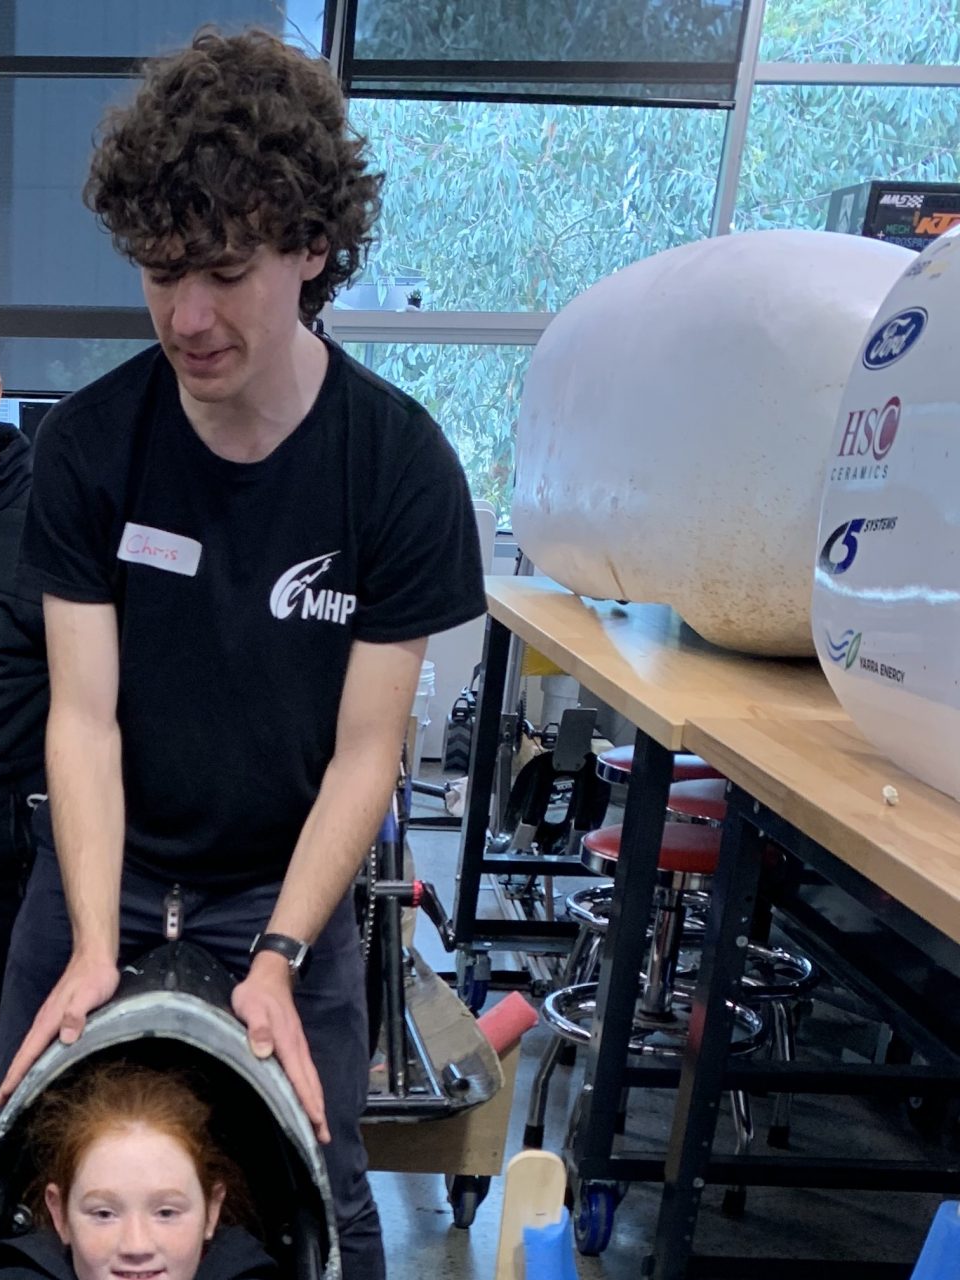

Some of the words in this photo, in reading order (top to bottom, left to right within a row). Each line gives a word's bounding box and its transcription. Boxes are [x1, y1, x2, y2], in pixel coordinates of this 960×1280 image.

[915, 213, 960, 234] KT
[885, 236, 937, 249] AEROSPAC
[868, 315, 918, 363] Ford
[837, 396, 901, 461] HSC
[831, 465, 889, 481] CERAMICS
[864, 516, 898, 533] SYSTEMS
[125, 534, 179, 561] Chris
[301, 588, 357, 625] MHP
[859, 656, 880, 675] YARRA
[880, 664, 906, 683] ENERGY
